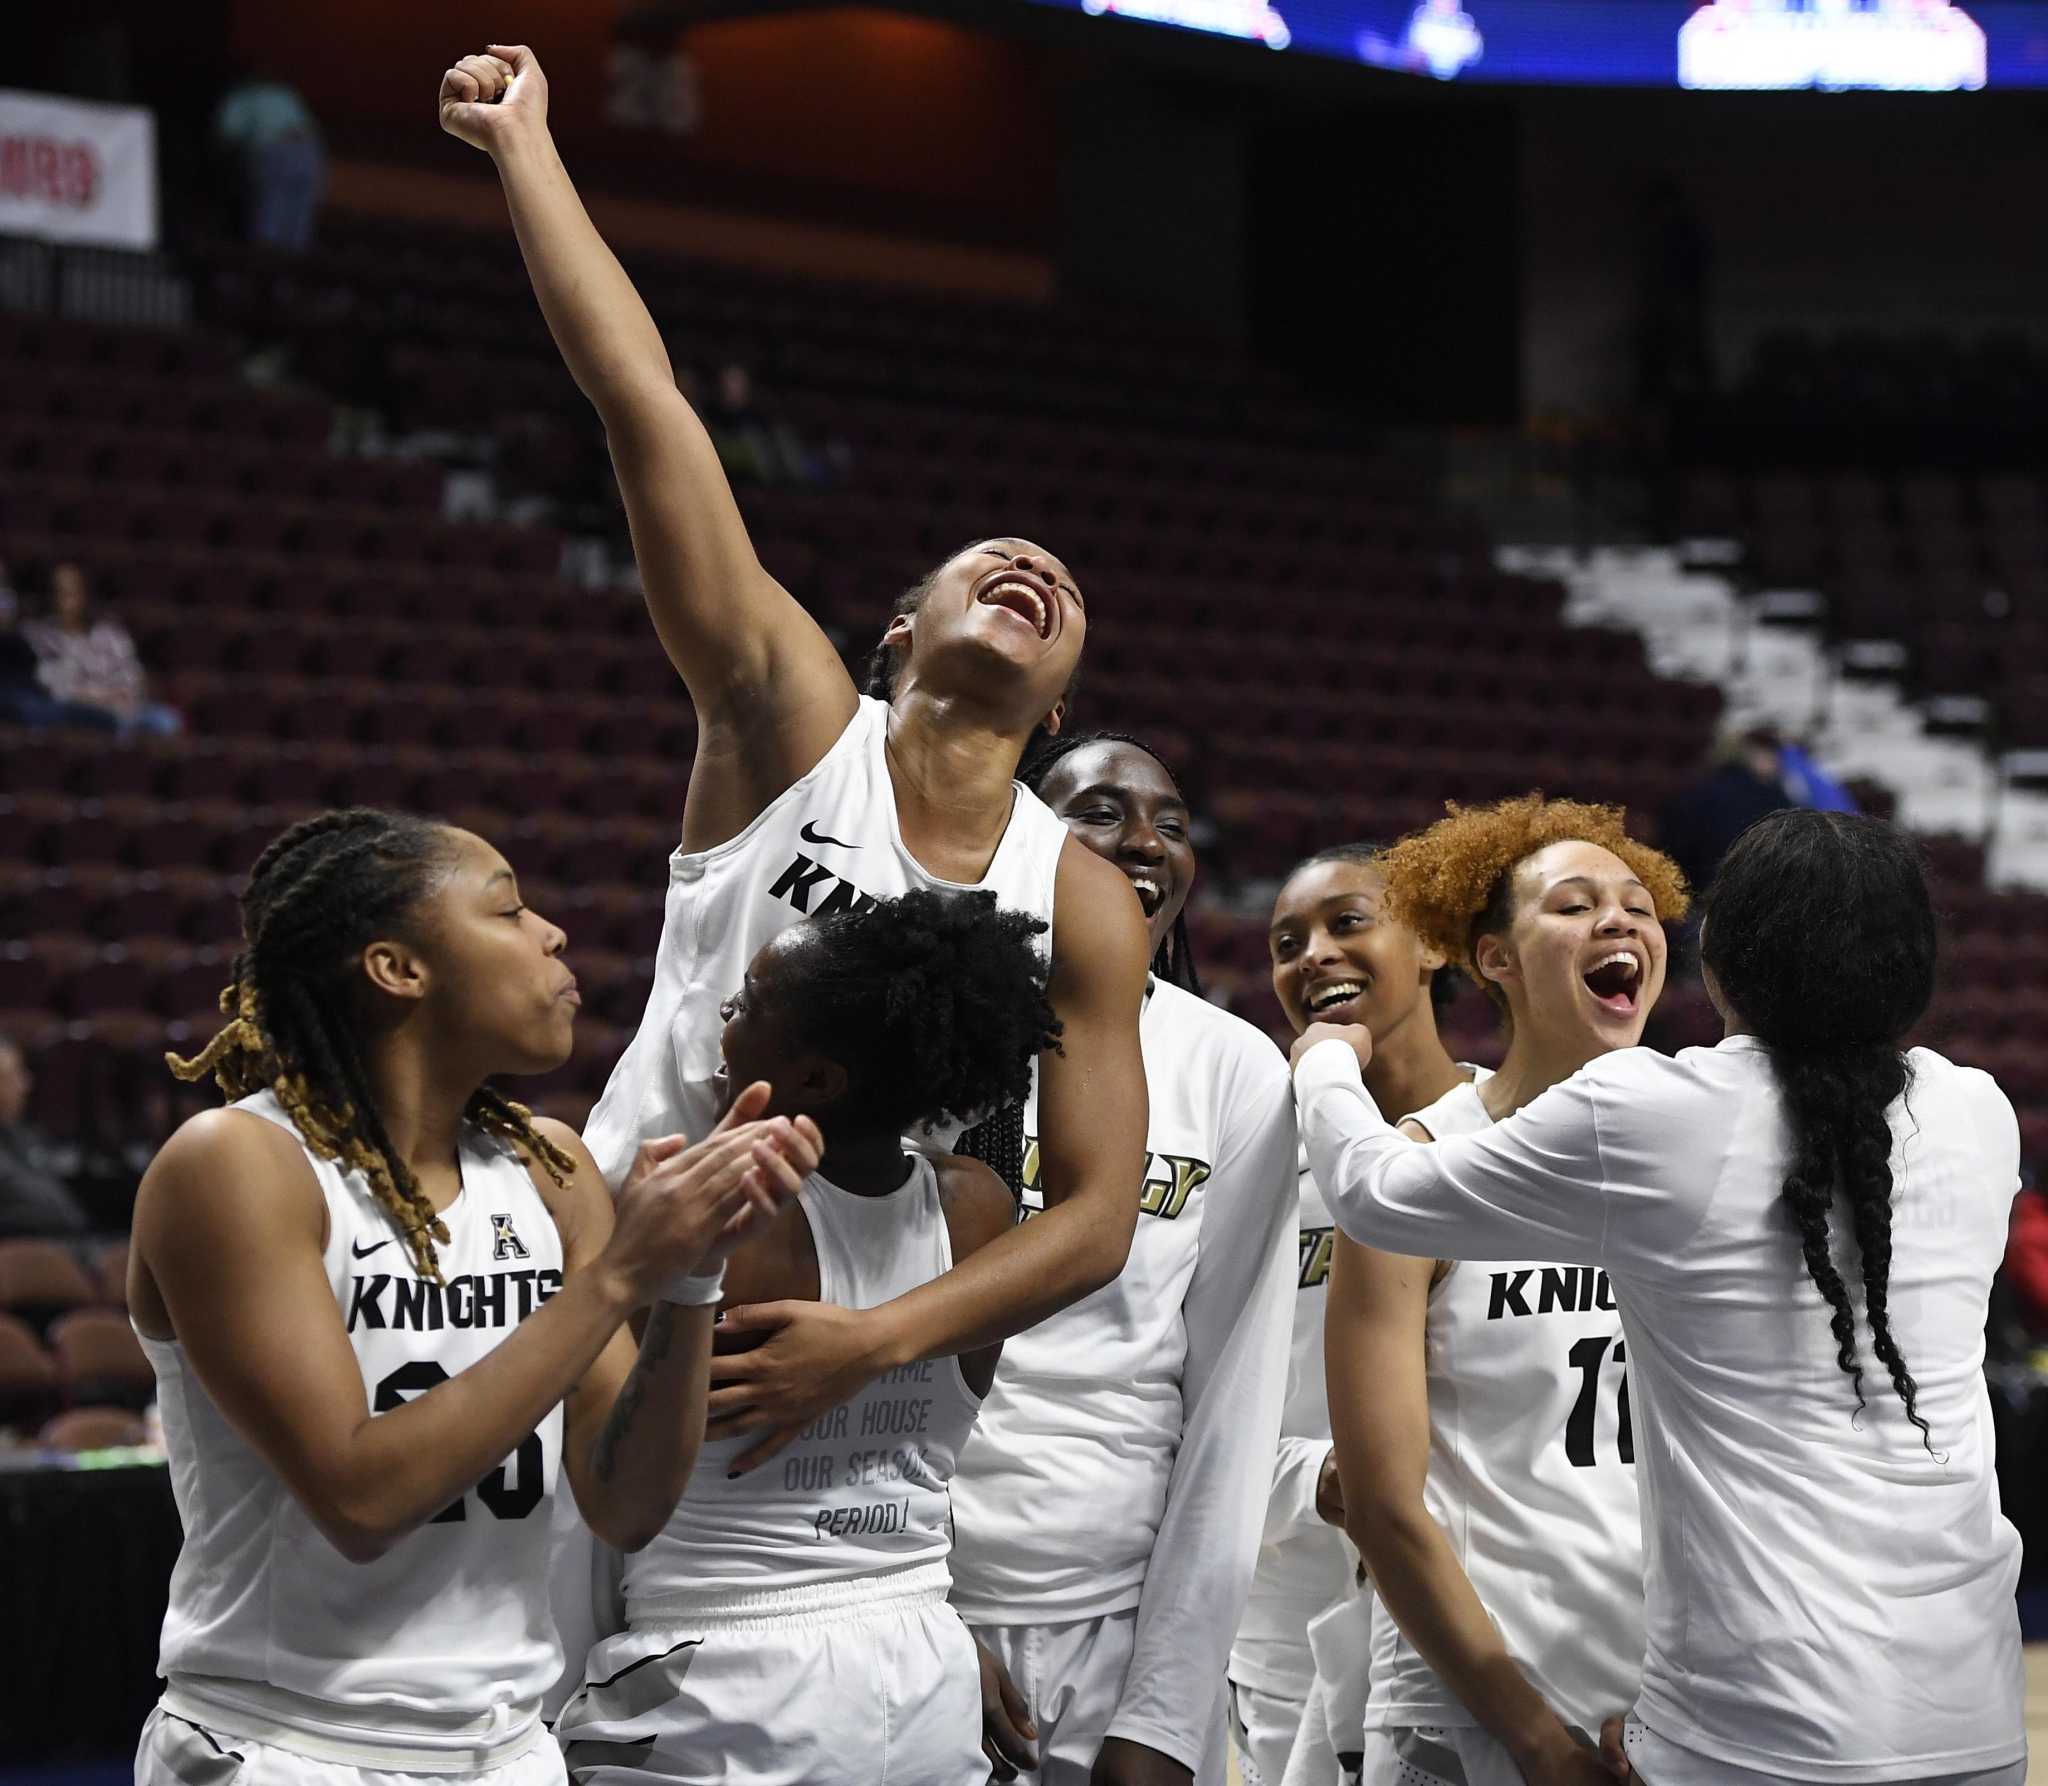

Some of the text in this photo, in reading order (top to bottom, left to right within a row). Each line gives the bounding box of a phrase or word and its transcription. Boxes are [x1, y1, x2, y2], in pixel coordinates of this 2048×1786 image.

[860, 1400, 933, 1436] HOUSE
[784, 1455, 834, 1492] OUR
[814, 1498, 909, 1540] PERIOD!
